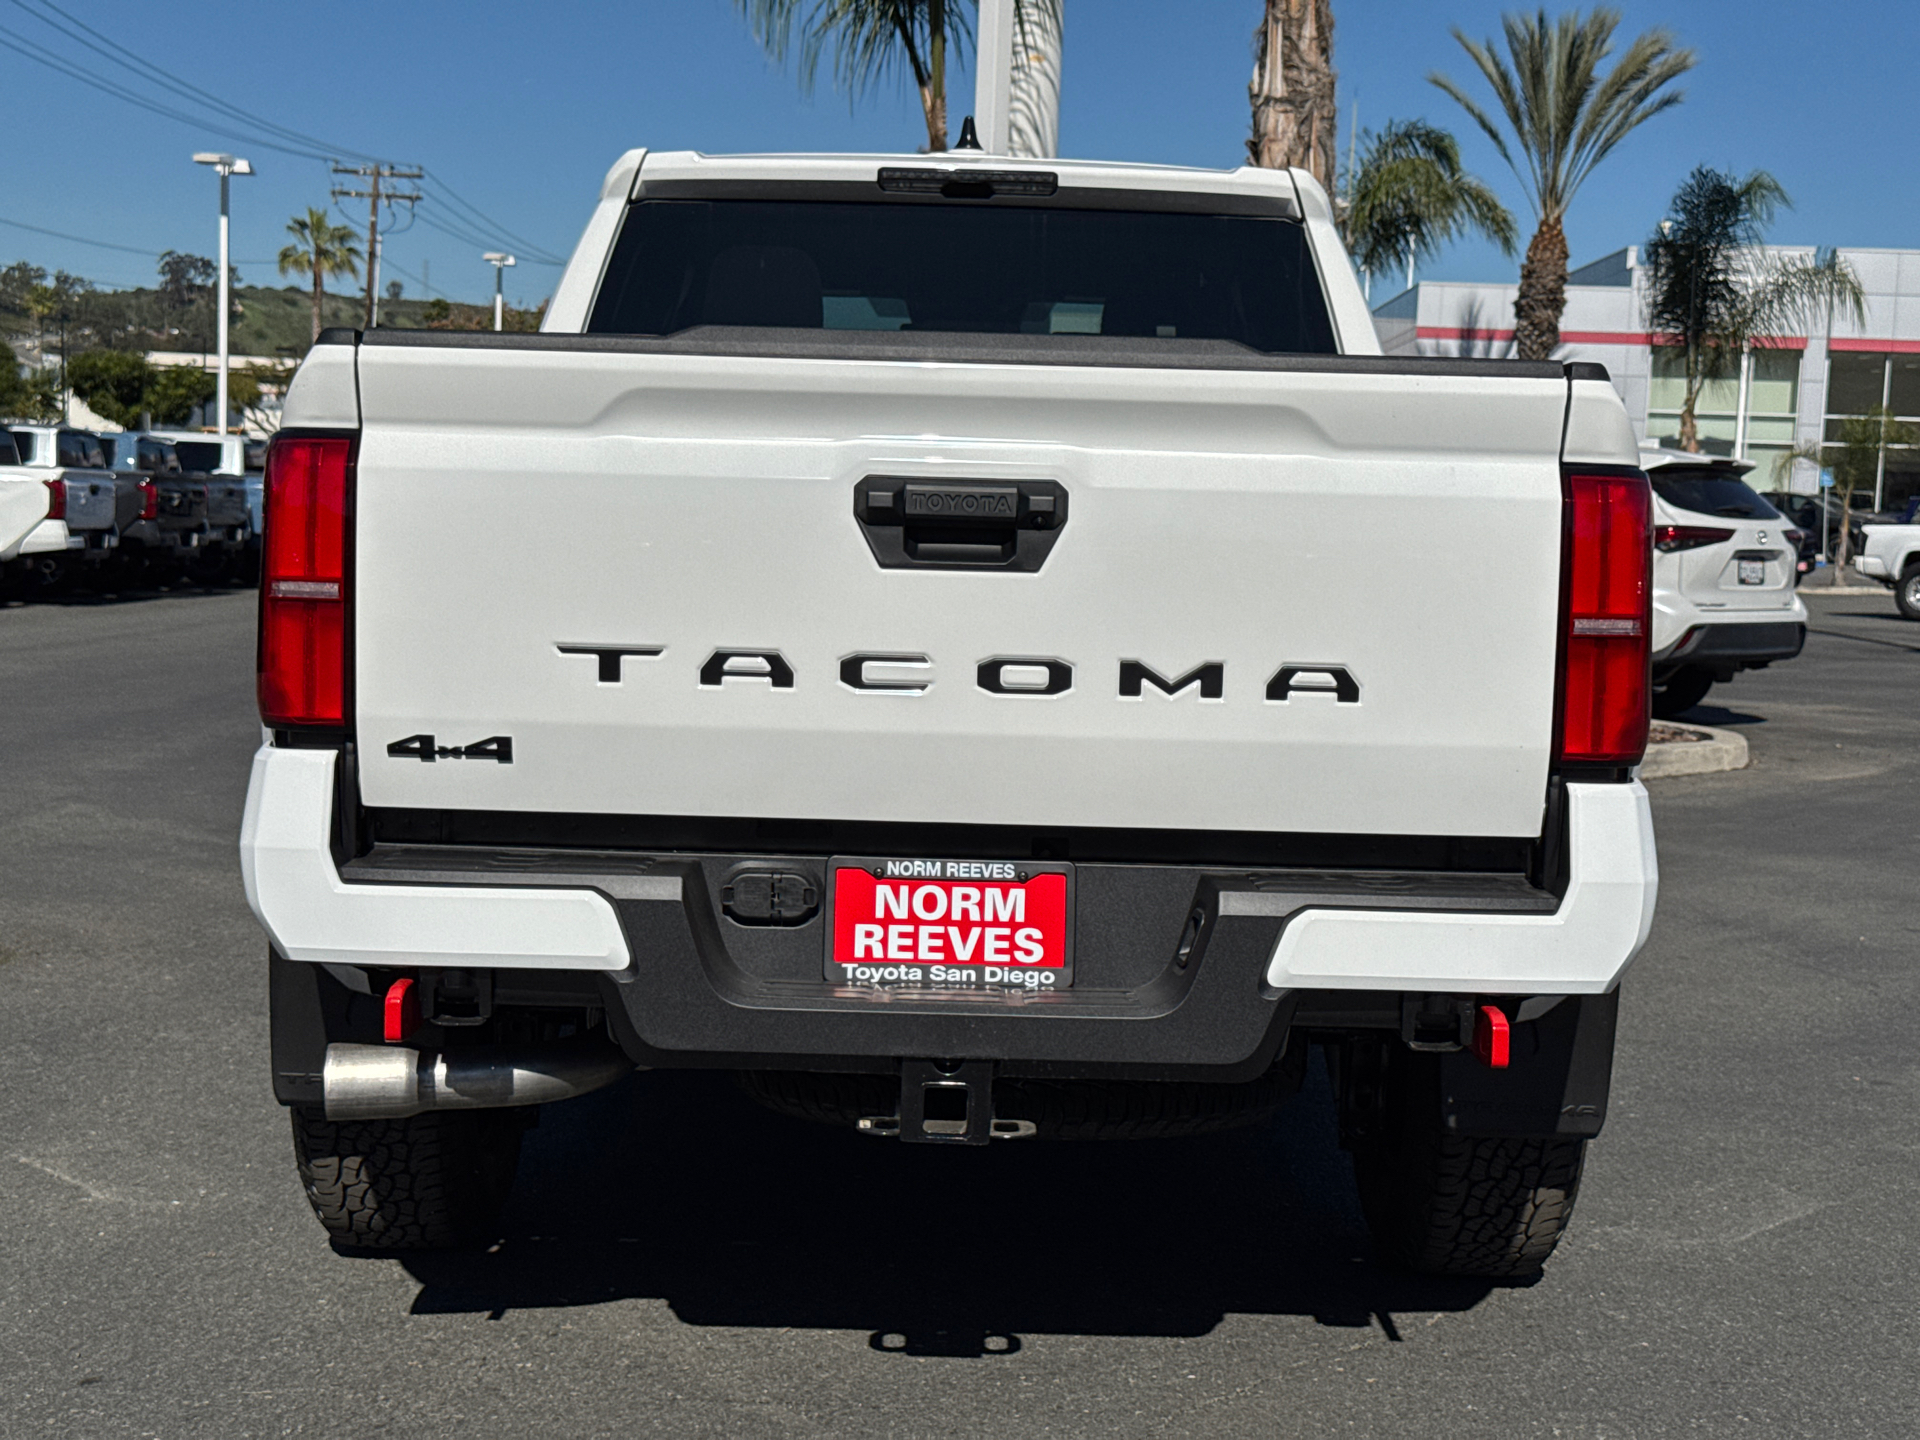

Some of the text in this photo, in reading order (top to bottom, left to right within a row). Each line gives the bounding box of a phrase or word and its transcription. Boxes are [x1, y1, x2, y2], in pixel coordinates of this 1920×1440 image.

[910, 492, 1012, 514] TOYOTA
[556, 643, 1360, 703] TACOMA
[886, 861, 1016, 879] NORM REEVES
[875, 885, 1026, 922] NORM
[854, 923, 1044, 964] REEVES
[841, 963, 1056, 988] Toyota San Diego
